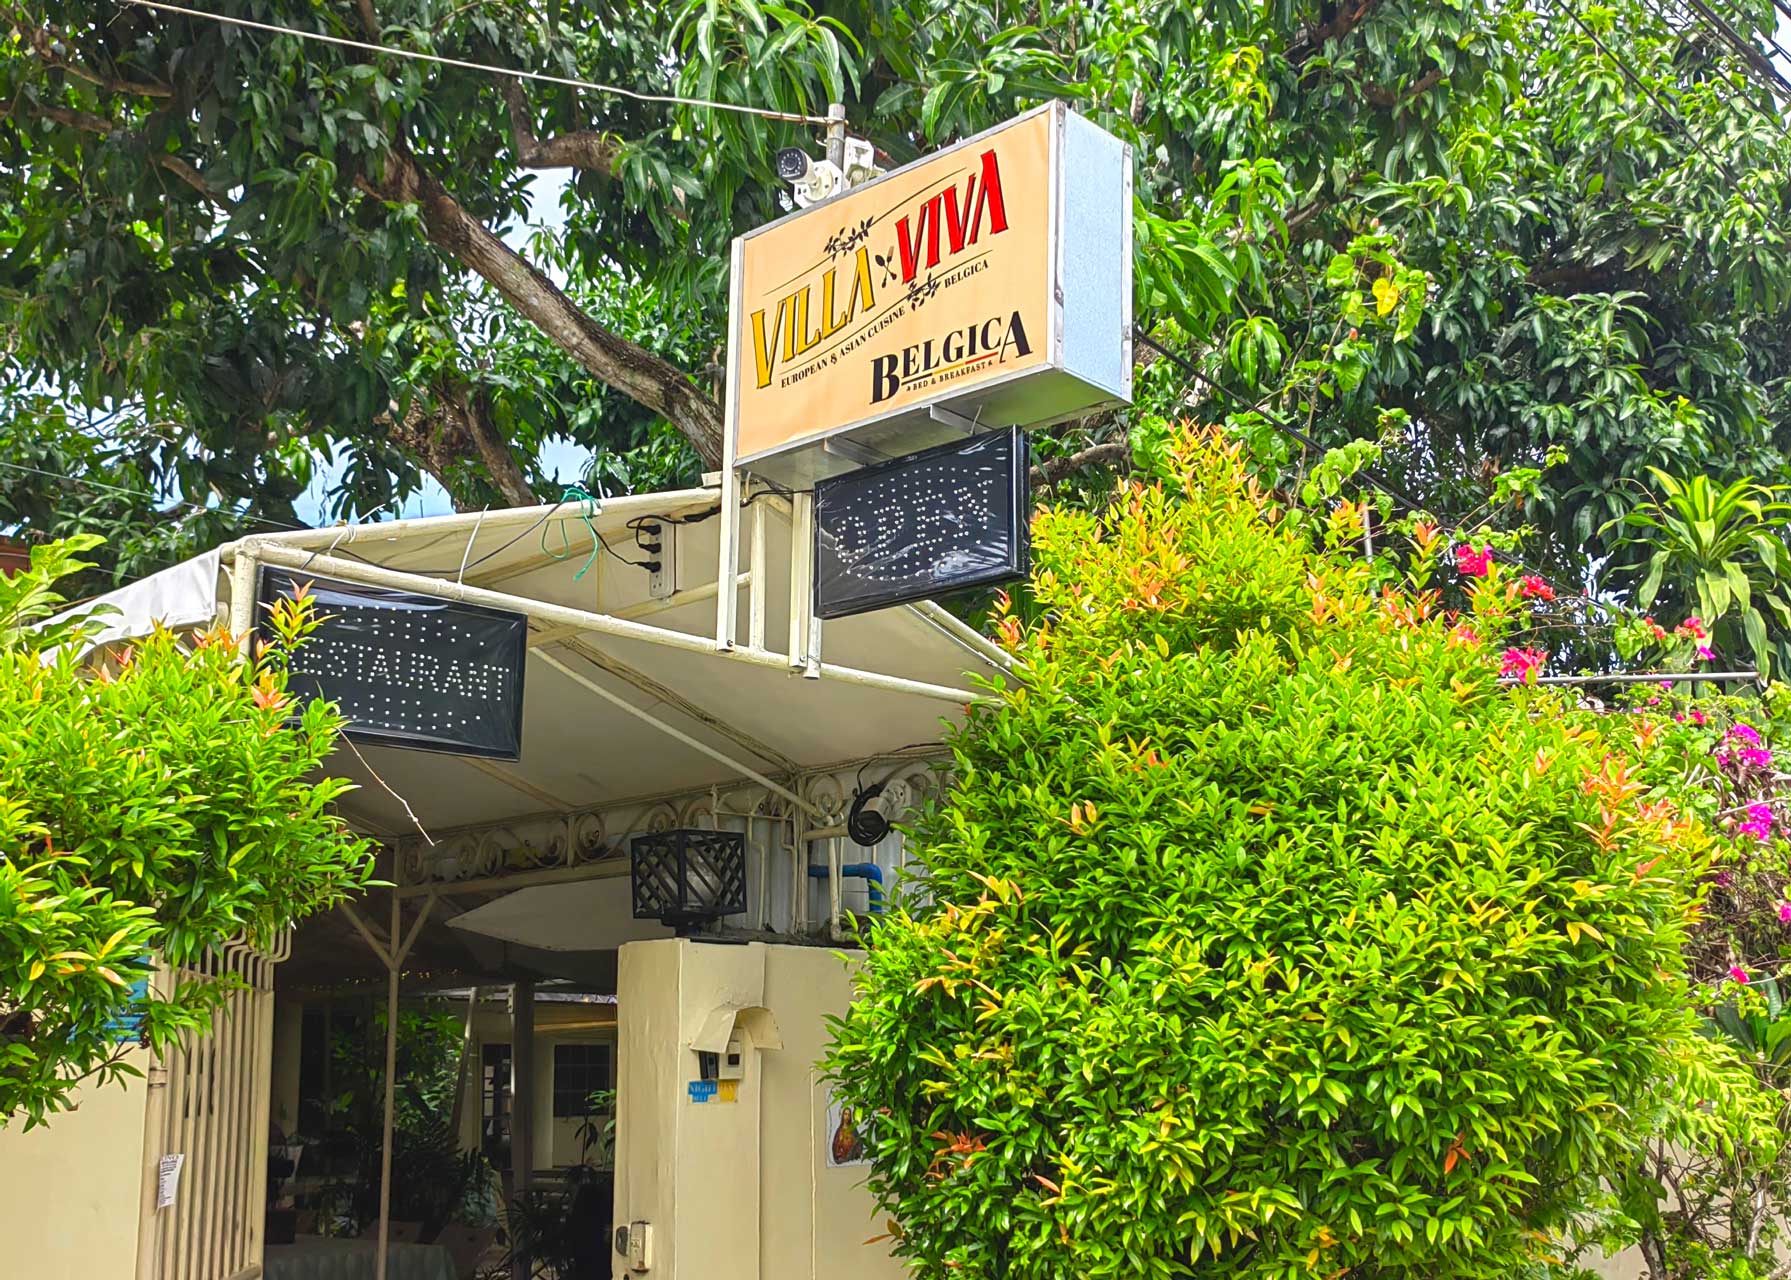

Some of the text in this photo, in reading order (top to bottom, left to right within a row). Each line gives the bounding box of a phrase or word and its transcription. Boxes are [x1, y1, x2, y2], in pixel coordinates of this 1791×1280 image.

[750, 149, 1009, 389] VILLA VIVA
[780, 357, 828, 388] EUROPEAN
[839, 332, 868, 358] ASIAN
[867, 306, 905, 338] CUISINE
[944, 259, 989, 288] BELGICA
[869, 310, 1033, 405] BELGICA
[913, 380, 928, 391] BED
[939, 363, 986, 383] BREAKFAST
[835, 479, 994, 564] OPEN
